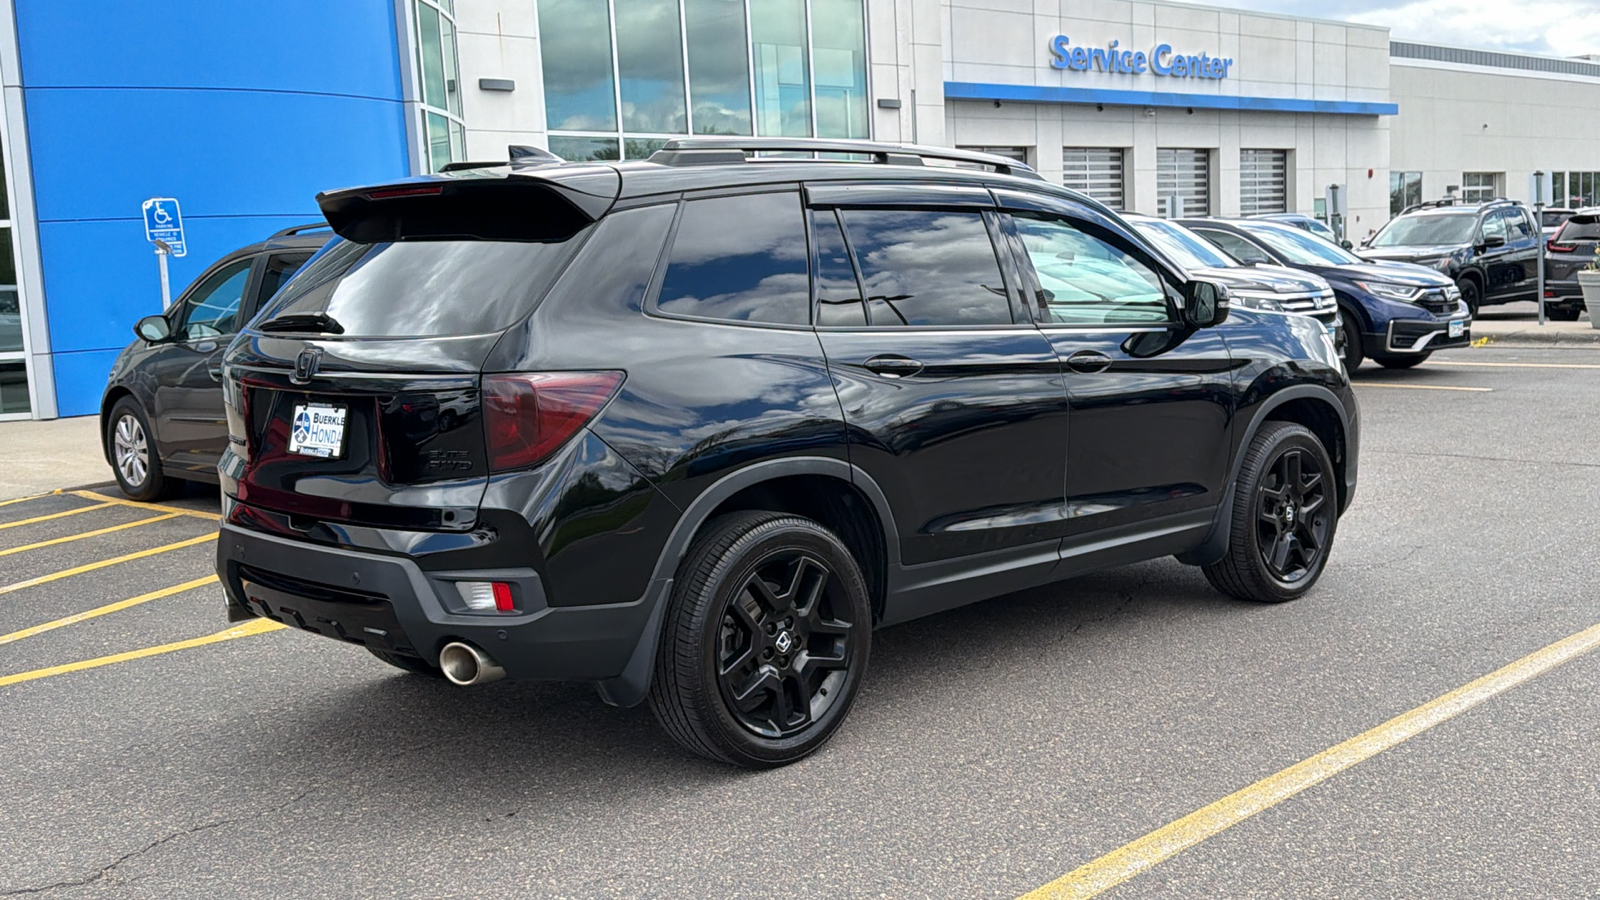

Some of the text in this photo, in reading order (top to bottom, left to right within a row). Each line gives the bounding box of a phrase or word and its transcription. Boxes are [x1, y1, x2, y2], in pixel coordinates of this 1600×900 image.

[1051, 34, 1233, 79] Service Center
[312, 412, 346, 426] BUERKLE
[310, 424, 342, 445] HONDA
